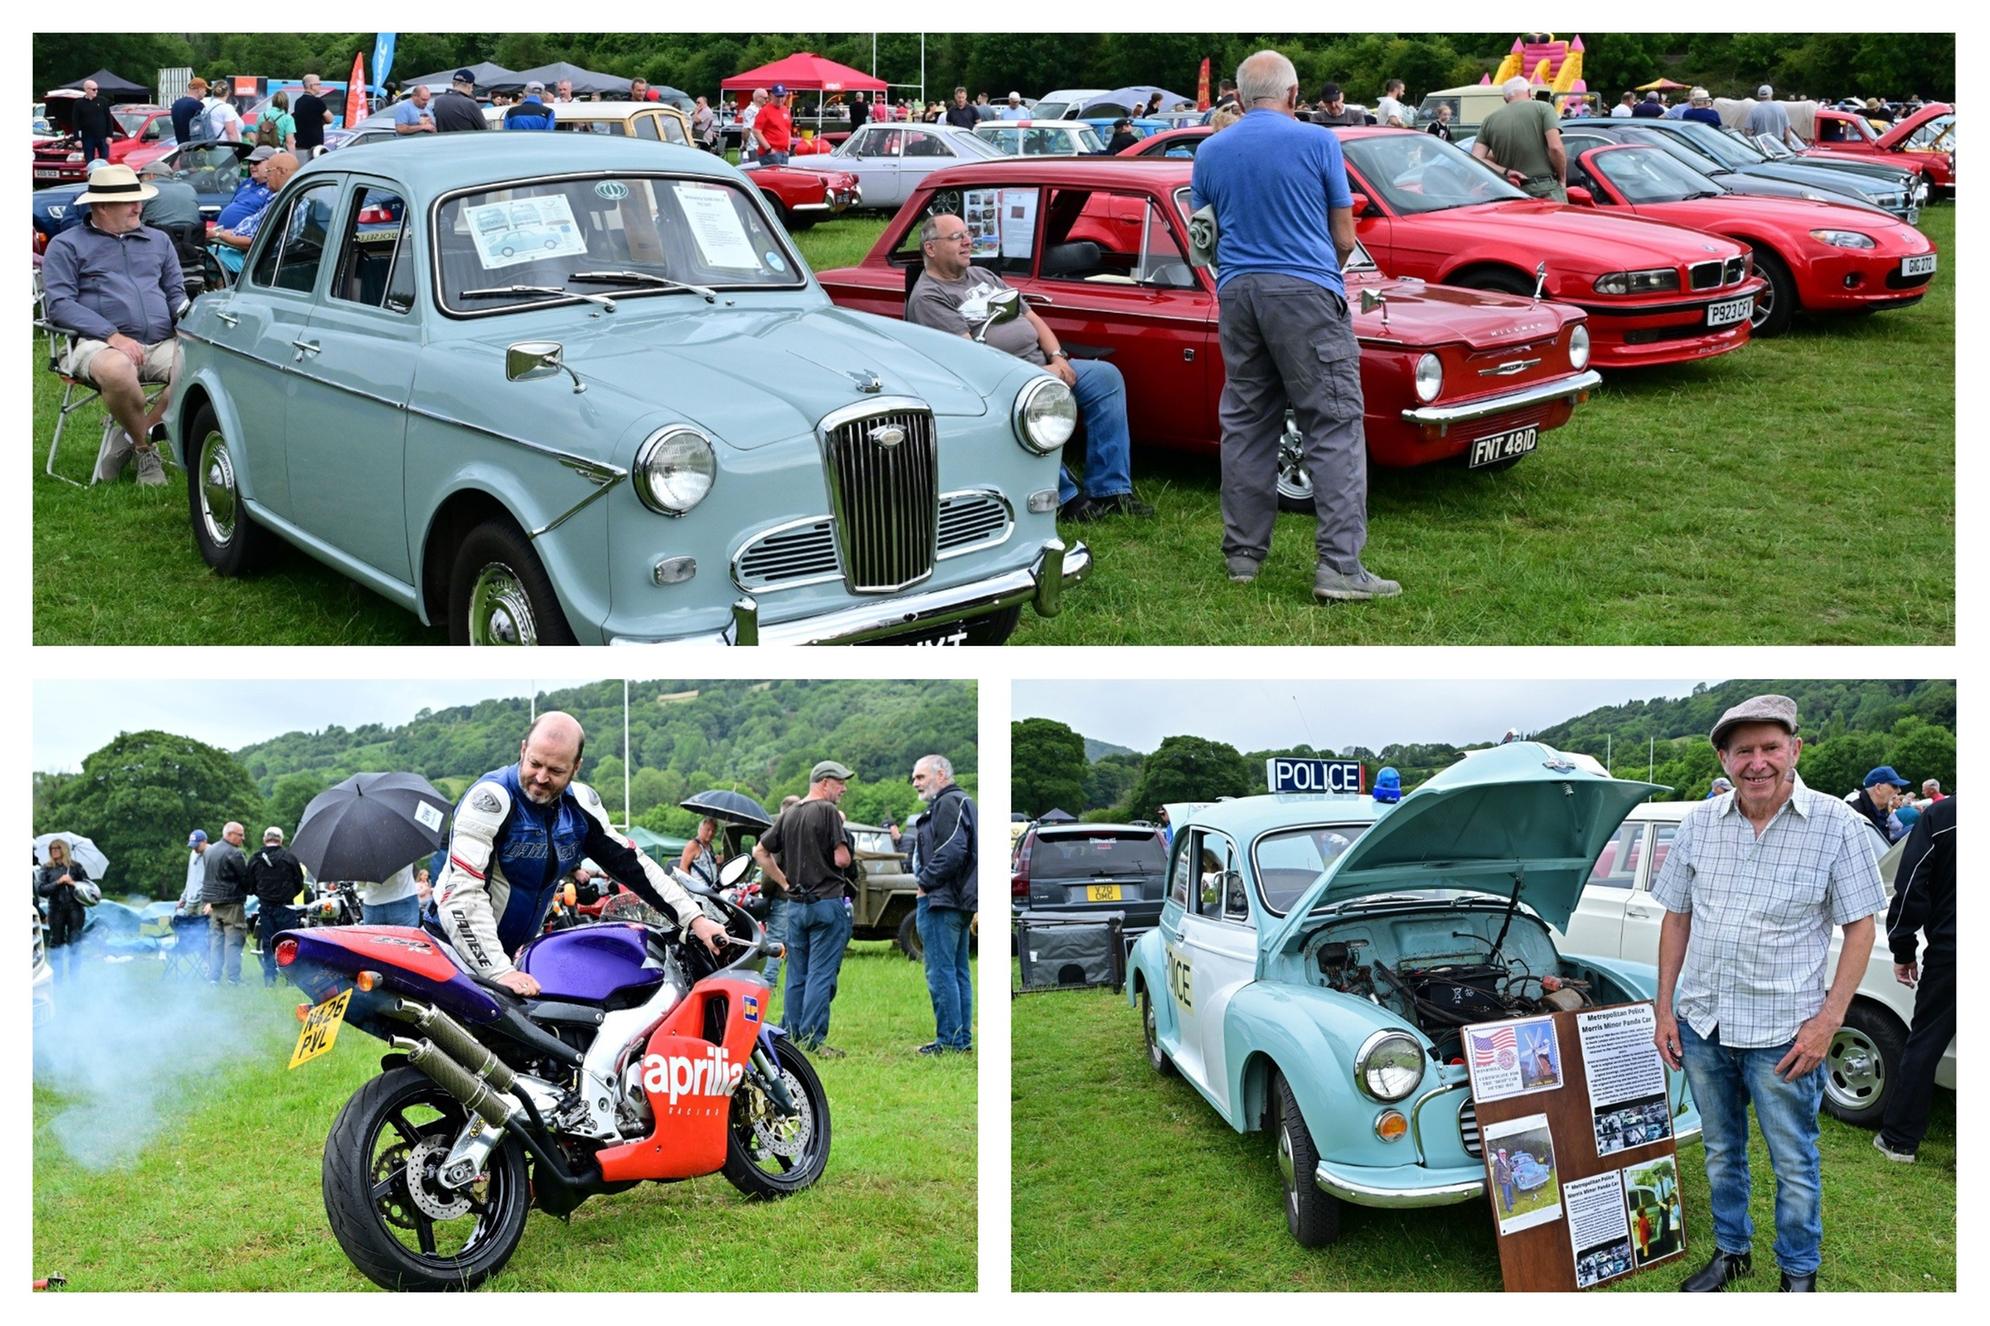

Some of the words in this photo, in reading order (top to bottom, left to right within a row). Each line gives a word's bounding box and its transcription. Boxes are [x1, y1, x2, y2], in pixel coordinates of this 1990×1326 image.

[1909, 259, 1920, 273] GIG
[1921, 257, 1932, 271] 272
[1712, 303, 1736, 322] P923
[1490, 323, 1542, 337] HILLMAN
[1474, 436, 1504, 464] FNT
[1505, 428, 1537, 455] 481D
[1277, 762, 1359, 790] POLICE
[451, 910, 493, 967] DAINESE
[303, 994, 347, 1035] N426
[1582, 1024, 1603, 1033] Morris
[1604, 1021, 1622, 1030] Minor
[1623, 1018, 1641, 1027] Panda
[1587, 1010, 1628, 1022] Metropolitan
[1628, 1007, 1645, 1016] Police
[298, 1026, 327, 1059] PVL
[643, 1046, 744, 1106] aprilia
